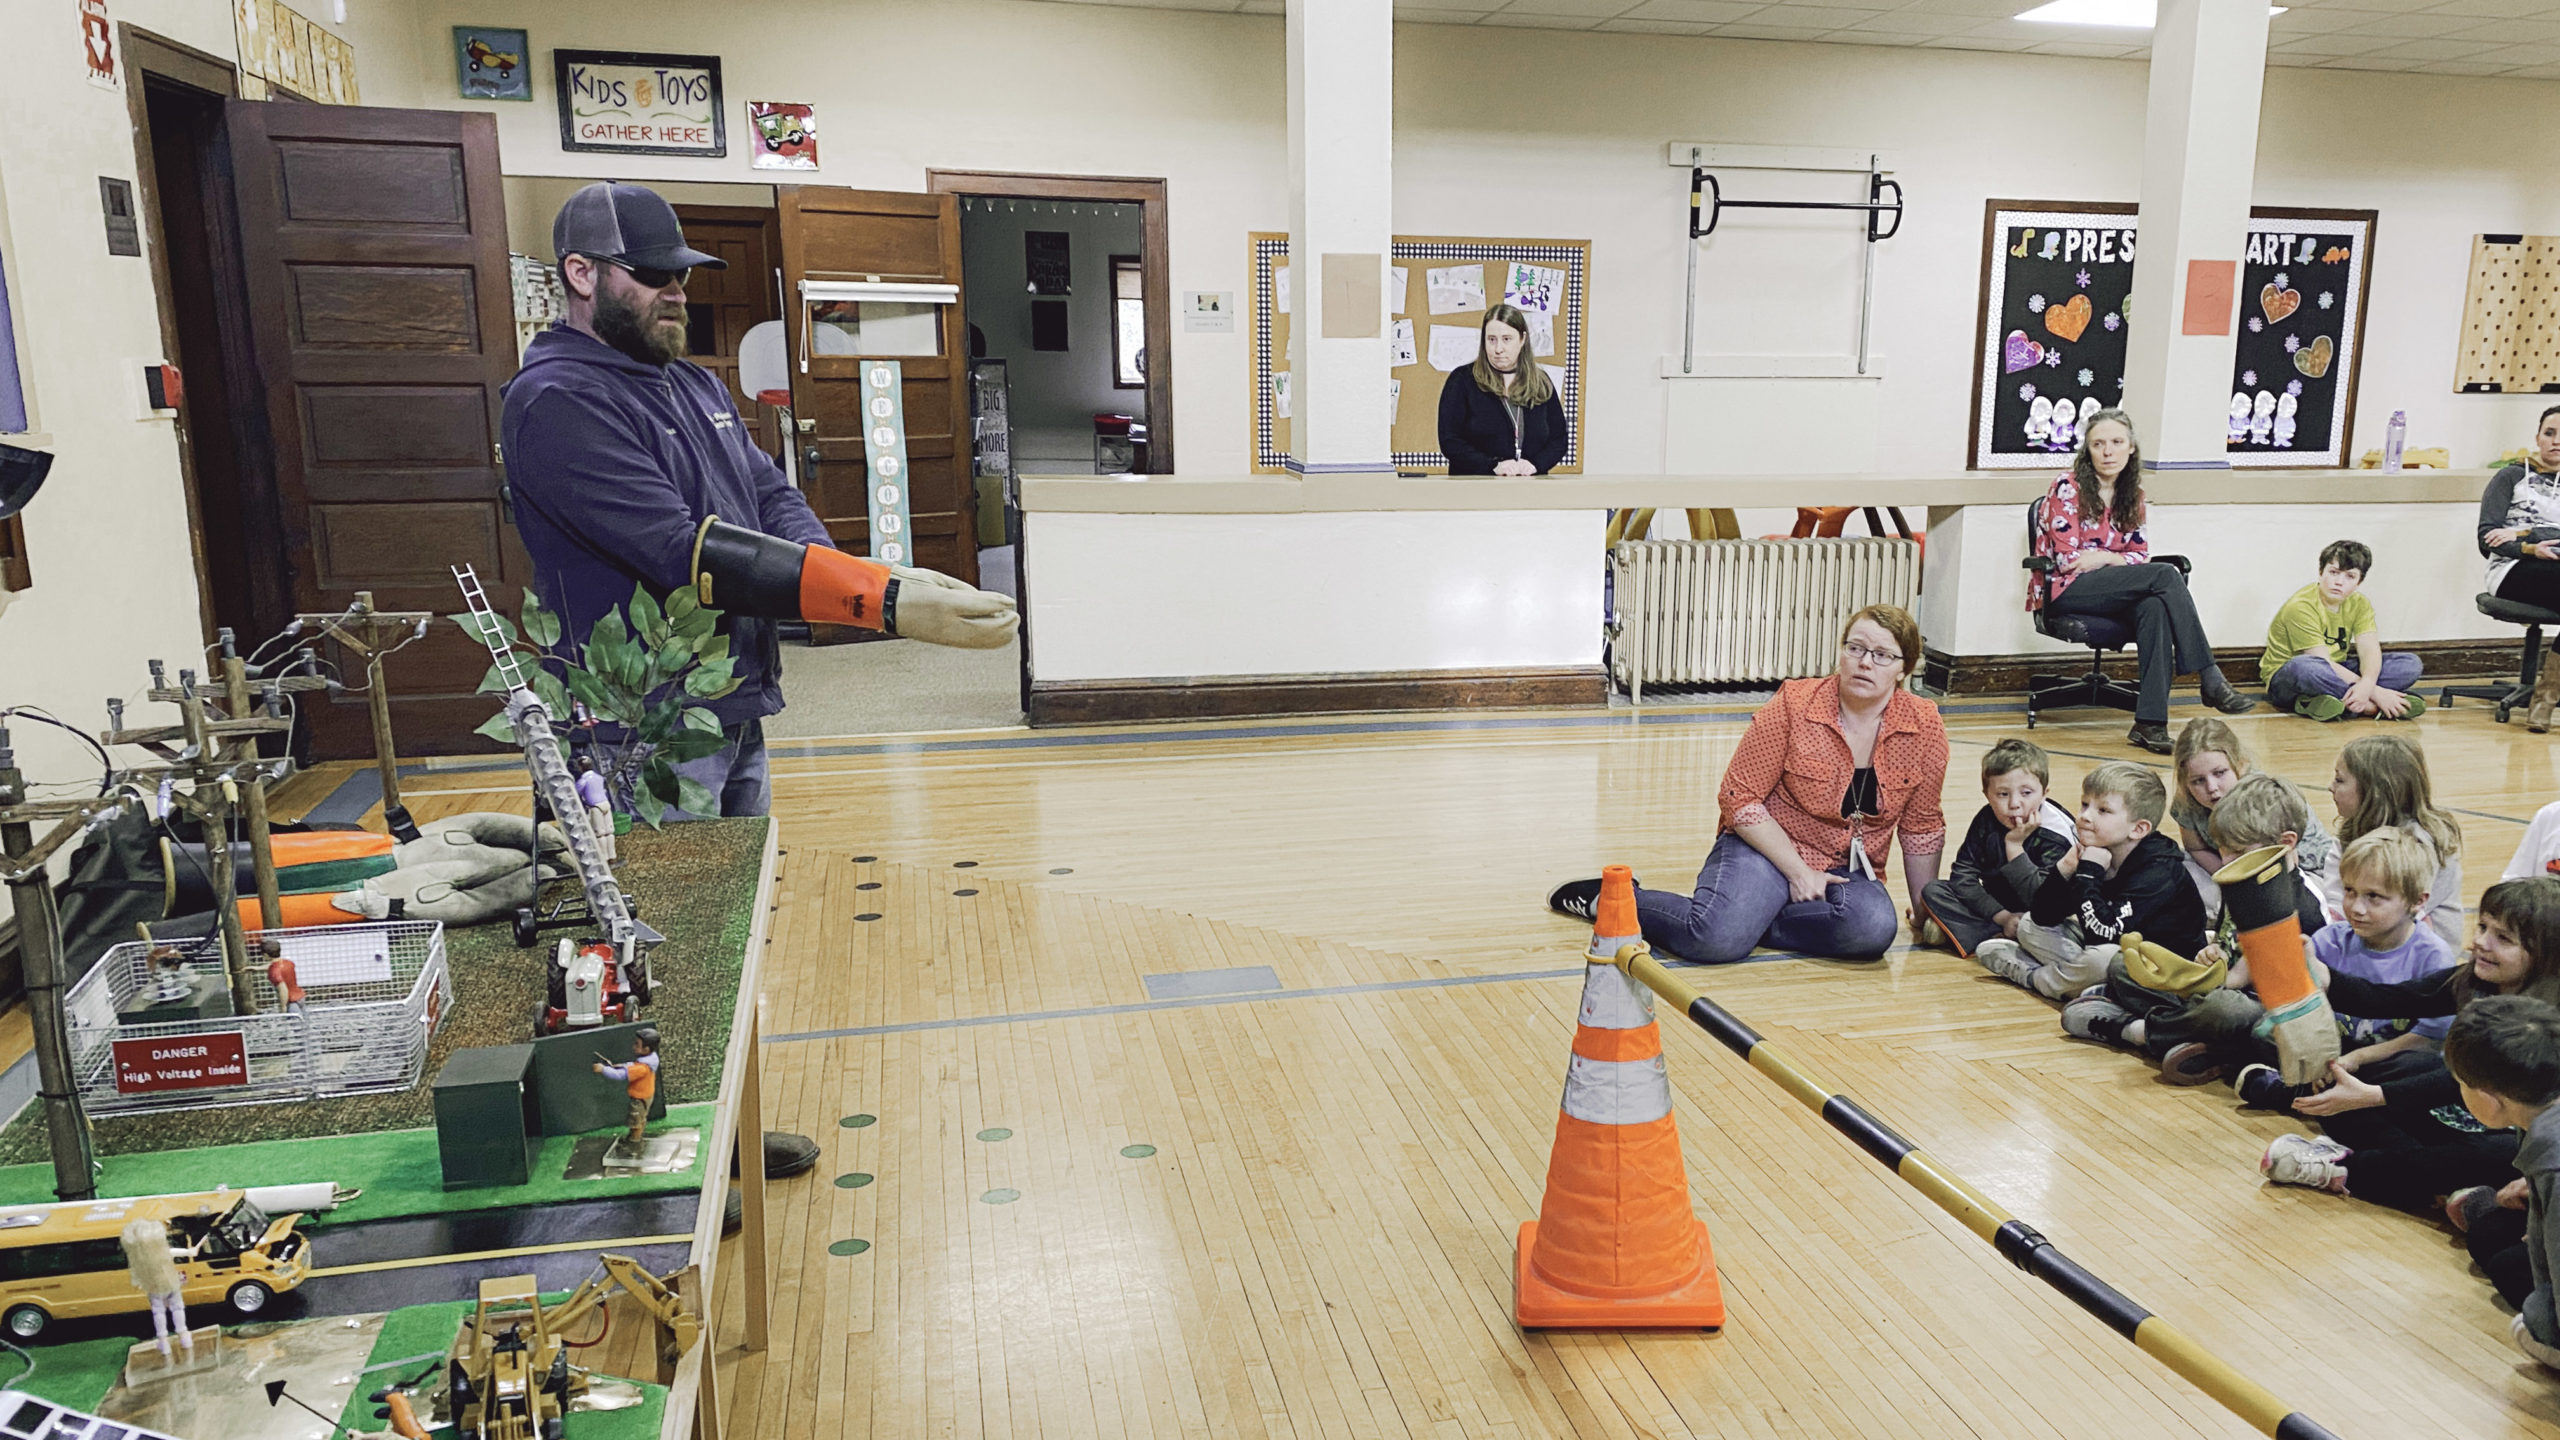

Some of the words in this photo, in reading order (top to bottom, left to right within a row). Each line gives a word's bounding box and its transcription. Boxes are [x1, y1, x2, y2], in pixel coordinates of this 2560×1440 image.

[571, 66, 627, 107] KIDS
[654, 70, 709, 105] TOYS
[581, 123, 652, 141] GATHER
[659, 126, 709, 143] HERE
[983, 390, 1000, 411] BIG
[981, 433, 1006, 453] MORE
[874, 370, 897, 560] WELCOME
[151, 1046, 208, 1060] DANGER
[123, 1071, 152, 1083] High
[156, 1068, 202, 1080] Voltage
[207, 1064, 241, 1076] Inside
